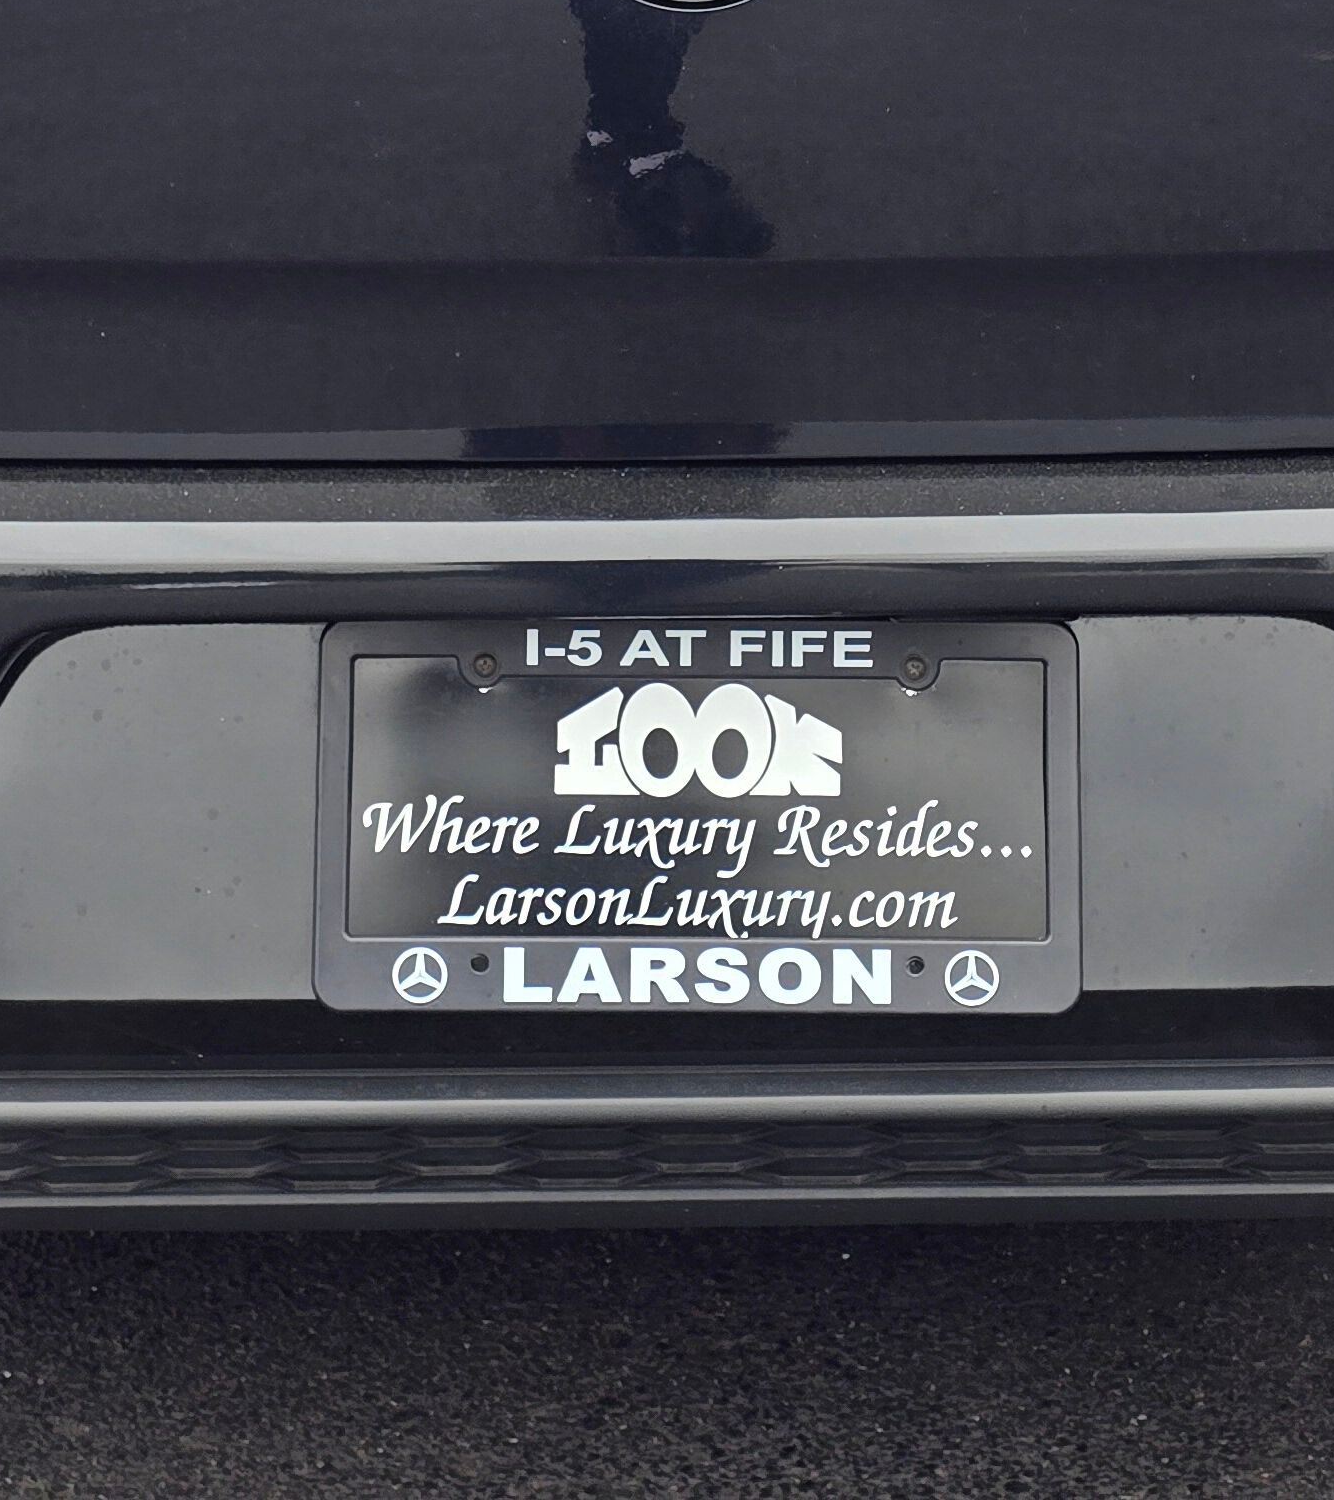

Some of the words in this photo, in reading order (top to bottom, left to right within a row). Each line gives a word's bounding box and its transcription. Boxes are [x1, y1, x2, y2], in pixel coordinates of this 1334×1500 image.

[525, 628, 603, 667] I-5
[619, 629, 707, 668] AT
[729, 630, 875, 669] FIFE
[553, 682, 843, 799] LOOK
[361, 793, 540, 856] Where
[552, 804, 757, 880] Luxury
[772, 799, 1034, 868] Resides...
[435, 873, 960, 940] LarsonLuxury.com
[501, 945, 893, 1006] LARSON
